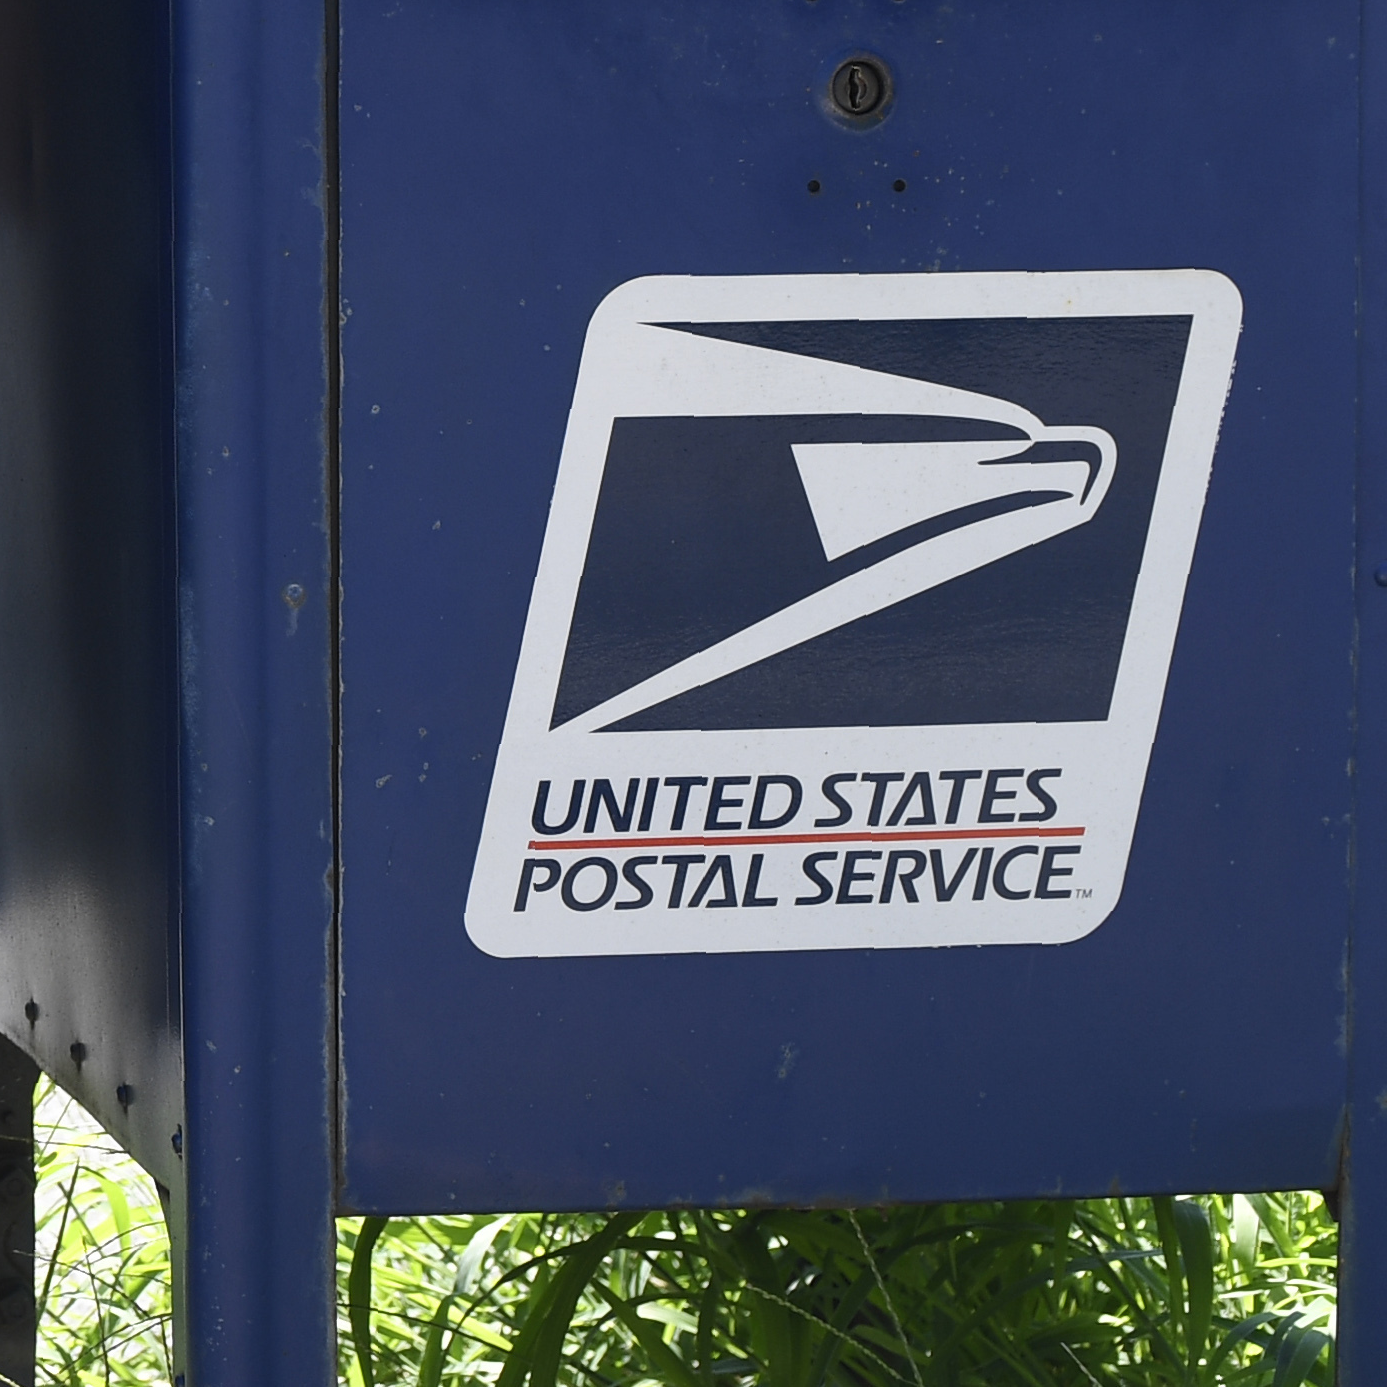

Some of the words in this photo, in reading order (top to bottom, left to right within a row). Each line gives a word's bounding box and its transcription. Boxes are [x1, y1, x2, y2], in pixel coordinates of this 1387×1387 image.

[532, 775, 802, 835] UNITED
[814, 768, 1062, 827] STATES
[514, 854, 778, 912] POSTAL
[795, 845, 1081, 905] SERVICE
